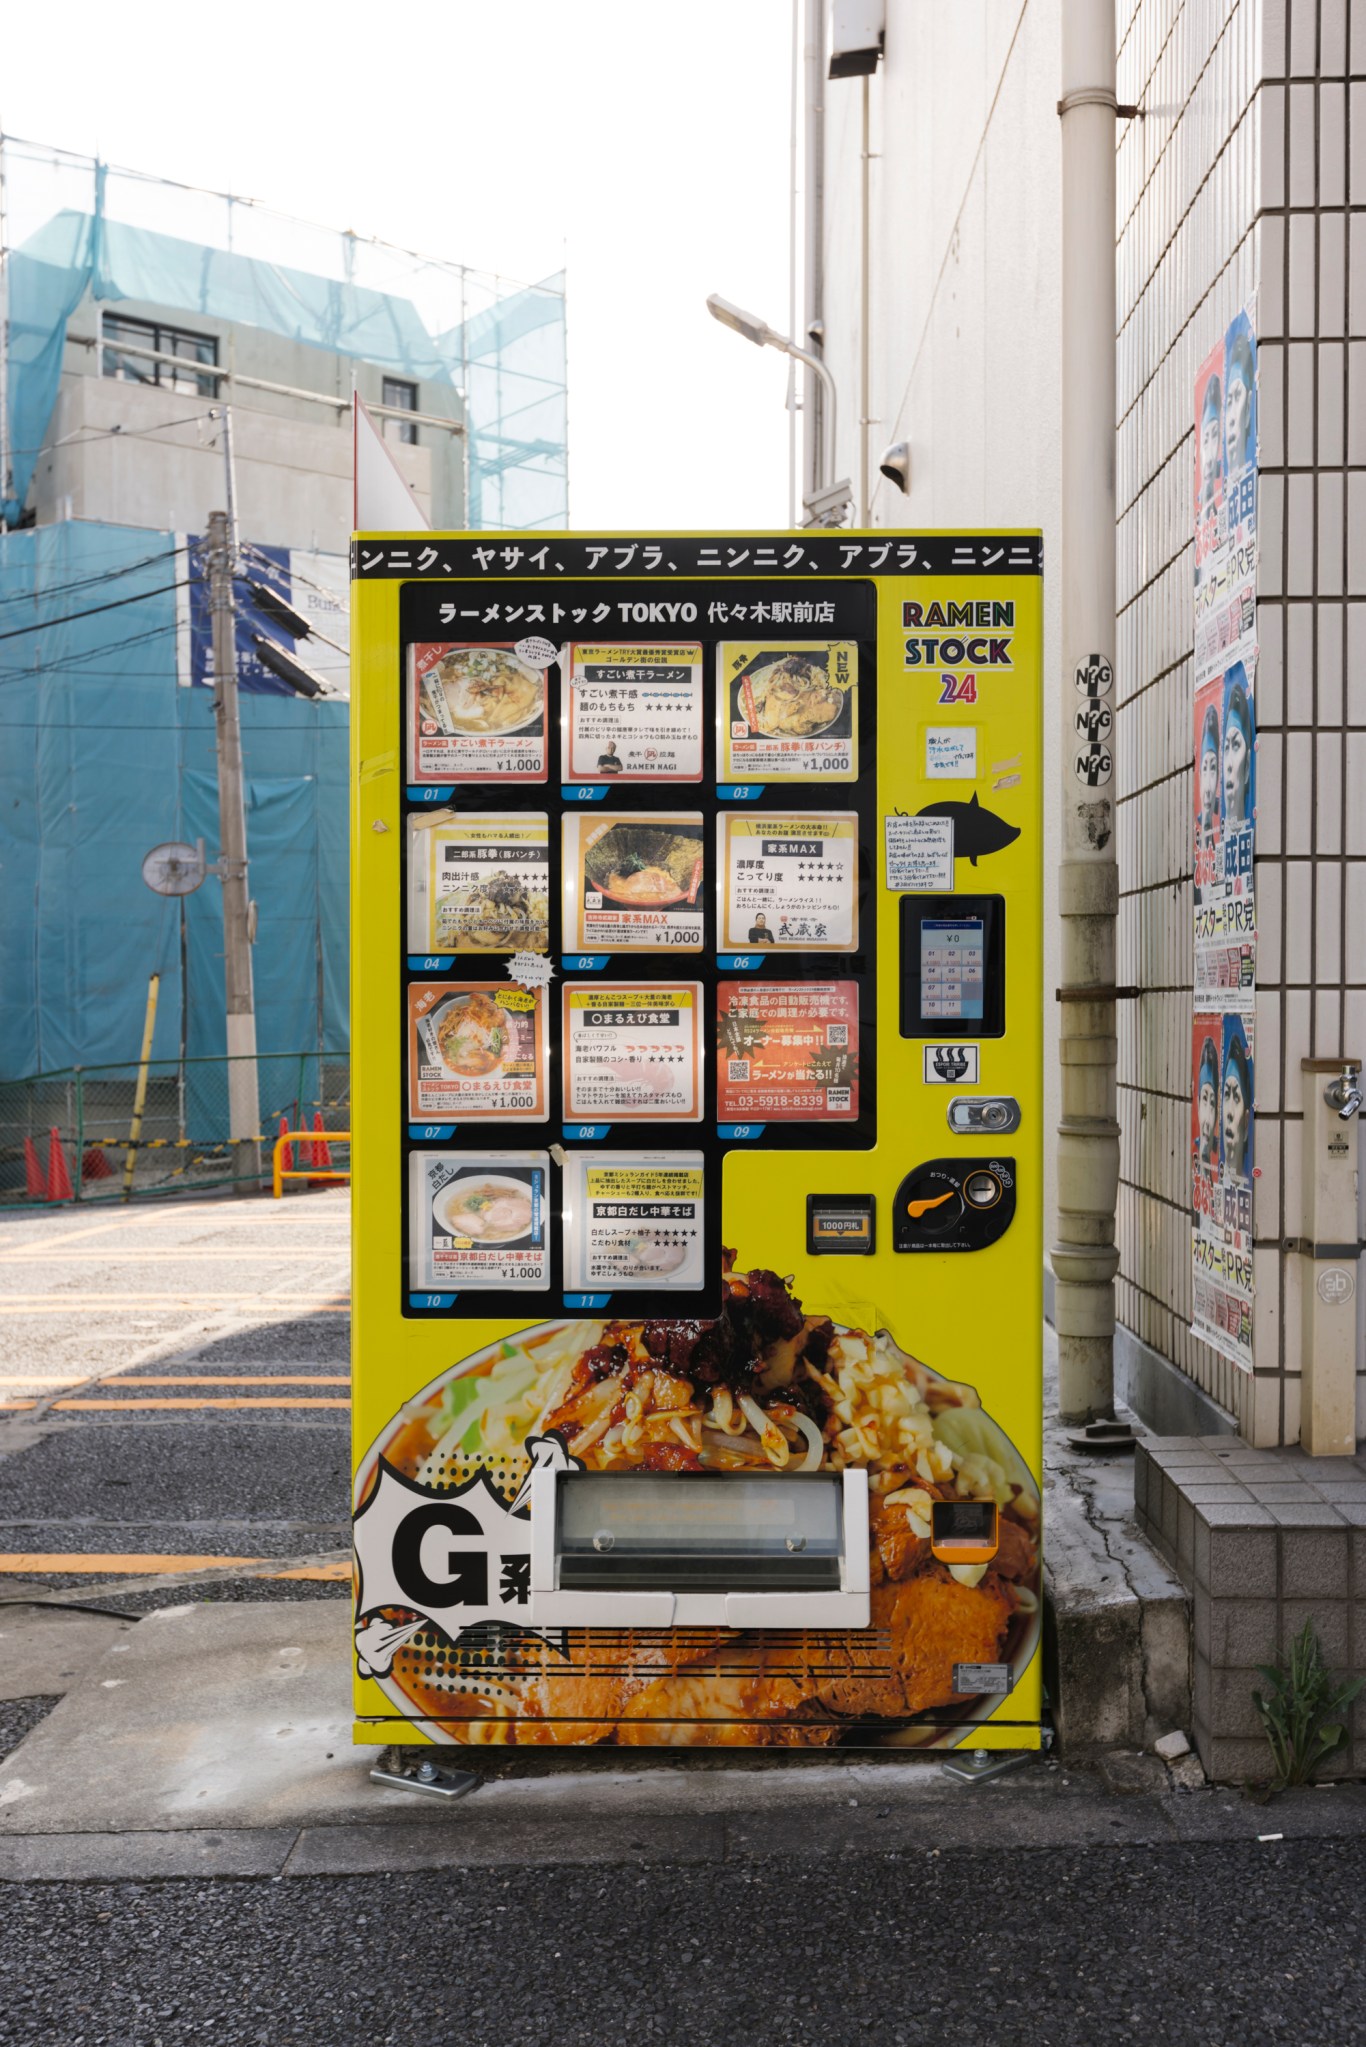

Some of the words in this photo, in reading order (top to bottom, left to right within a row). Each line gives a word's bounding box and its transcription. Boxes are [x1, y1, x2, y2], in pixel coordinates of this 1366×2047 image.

[351, 542, 1044, 573] ンニク、ヤサイ、アブラ、ニンニク、アブラ、ニンニ
[439, 602, 611, 624] ラーメンストック
[617, 602, 698, 623] TOKYO
[708, 601, 836, 623] 代々木駅前店
[902, 601, 1015, 628] RAMEN
[904, 636, 1012, 665] STOCK
[834, 651, 850, 684] NEW
[595, 669, 685, 680] すごい煮干ラーメン
[579, 688, 638, 699] すごい煮干感
[937, 672, 978, 704] 24
[579, 702, 635, 712] 麺のもちもち
[450, 738, 534, 748] すごい煮干ラーメン
[496, 759, 541, 772] ¥1,000
[626, 763, 656, 771] RAMEN
[657, 763, 677, 771] NAGI
[802, 757, 849, 772] ¥1,000
[423, 788, 439, 800] 01
[577, 787, 595, 800] 02
[733, 787, 749, 800] 03
[767, 843, 817, 854] 家系MAX
[736, 859, 765, 870] 濃厚度
[441, 871, 480, 881] 肉出汁感
[736, 872, 784, 882] こってり度
[621, 913, 668, 925] 家系MAX
[778, 923, 828, 937] 武蔵家
[655, 931, 700, 944] ¥1,000
[423, 958, 440, 970] 04
[578, 957, 594, 969] 05
[733, 957, 749, 969] 06
[728, 995, 849, 1006] 冷凍食品の自動販売機です。
[728, 1007, 849, 1018] ご家庭での調理が必要です。
[491, 1096, 534, 1108] ¥1,000
[424, 1127, 441, 1138] 07
[578, 1126, 595, 1138] 08
[733, 1126, 750, 1138] 09
[427, 1162, 445, 1180] 京都
[432, 1167, 455, 1190] 白だし
[595, 1206, 692, 1217] 京都白だし中華そば
[822, 1221, 860, 1231] 1000円札
[591, 1239, 631, 1247] こだわり食材
[459, 1252, 543, 1262] 京都白だし中華そば
[501, 1267, 542, 1279] ¥1,000
[426, 1295, 441, 1307] 10
[580, 1295, 594, 1307] 11
